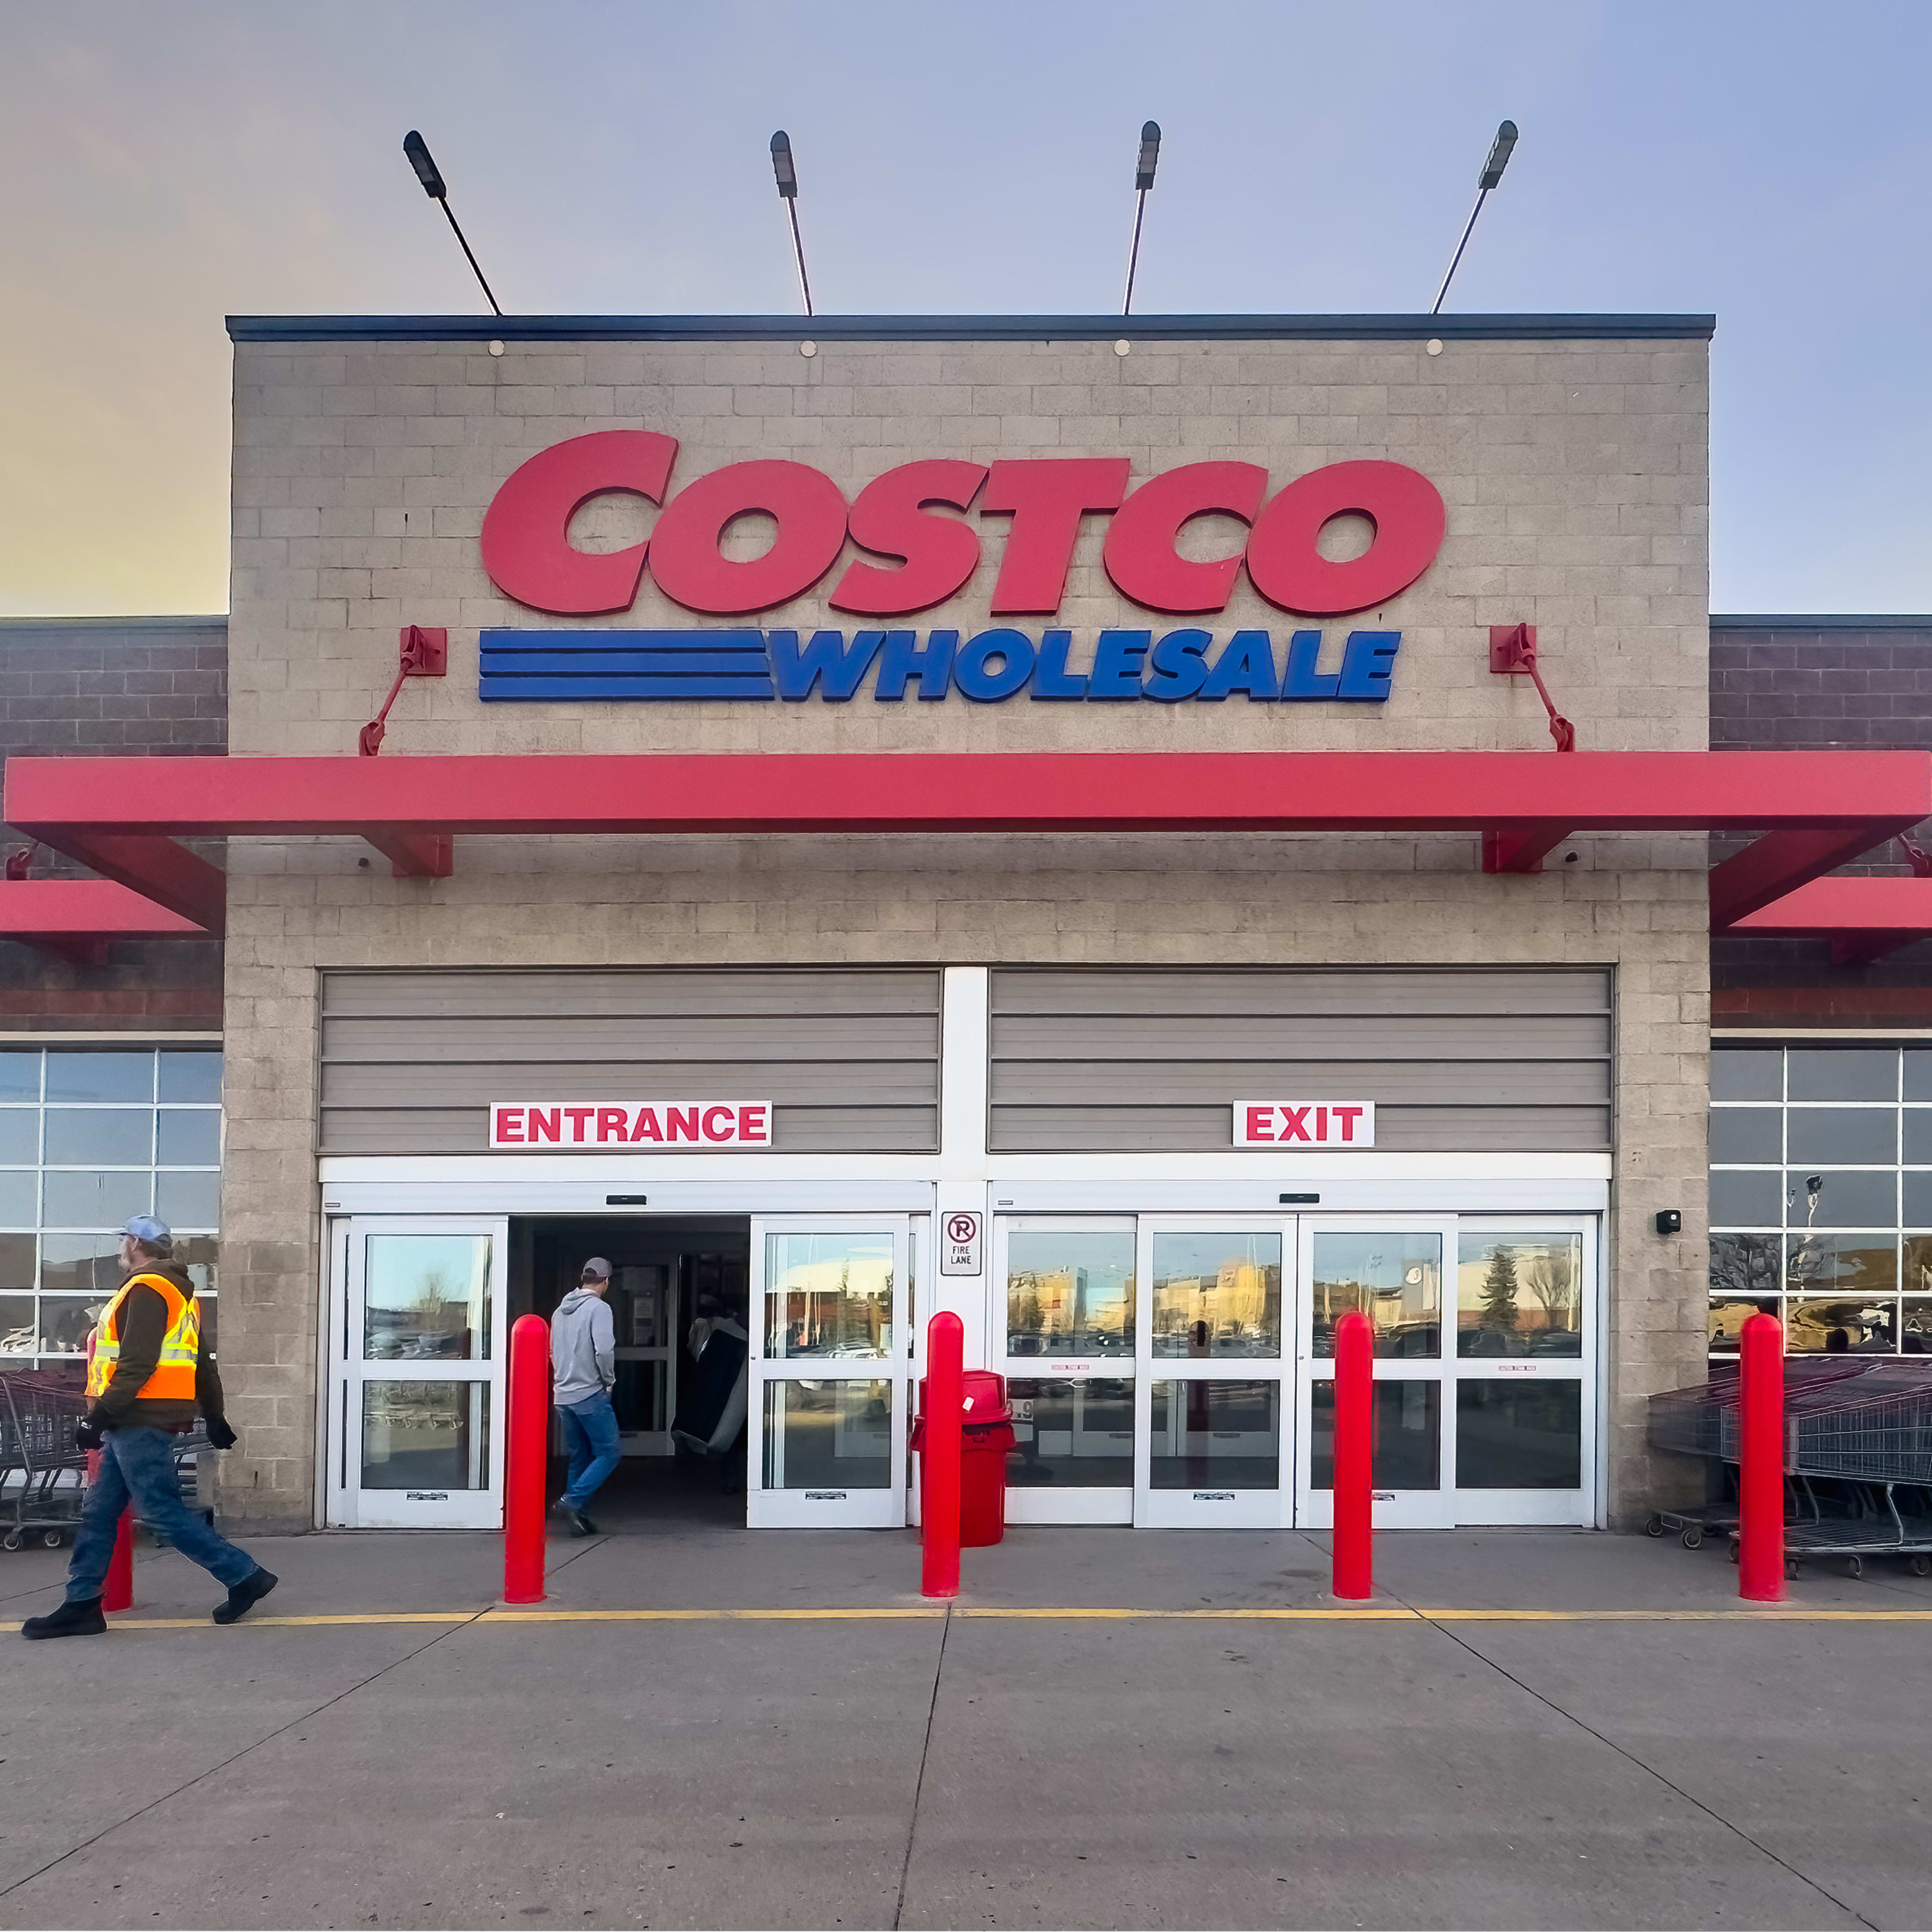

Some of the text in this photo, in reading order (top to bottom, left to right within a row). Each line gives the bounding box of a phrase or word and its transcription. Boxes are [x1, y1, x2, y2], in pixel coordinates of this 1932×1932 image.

[479, 430, 1445, 615] COSTCO
[769, 629, 1401, 702] WHOLESALE
[497, 1106, 767, 1142] ENTRANCE
[1246, 1107, 1363, 1141] EXIT
[951, 1255, 971, 1264] LANE
[952, 1246, 970, 1254] FIRE
